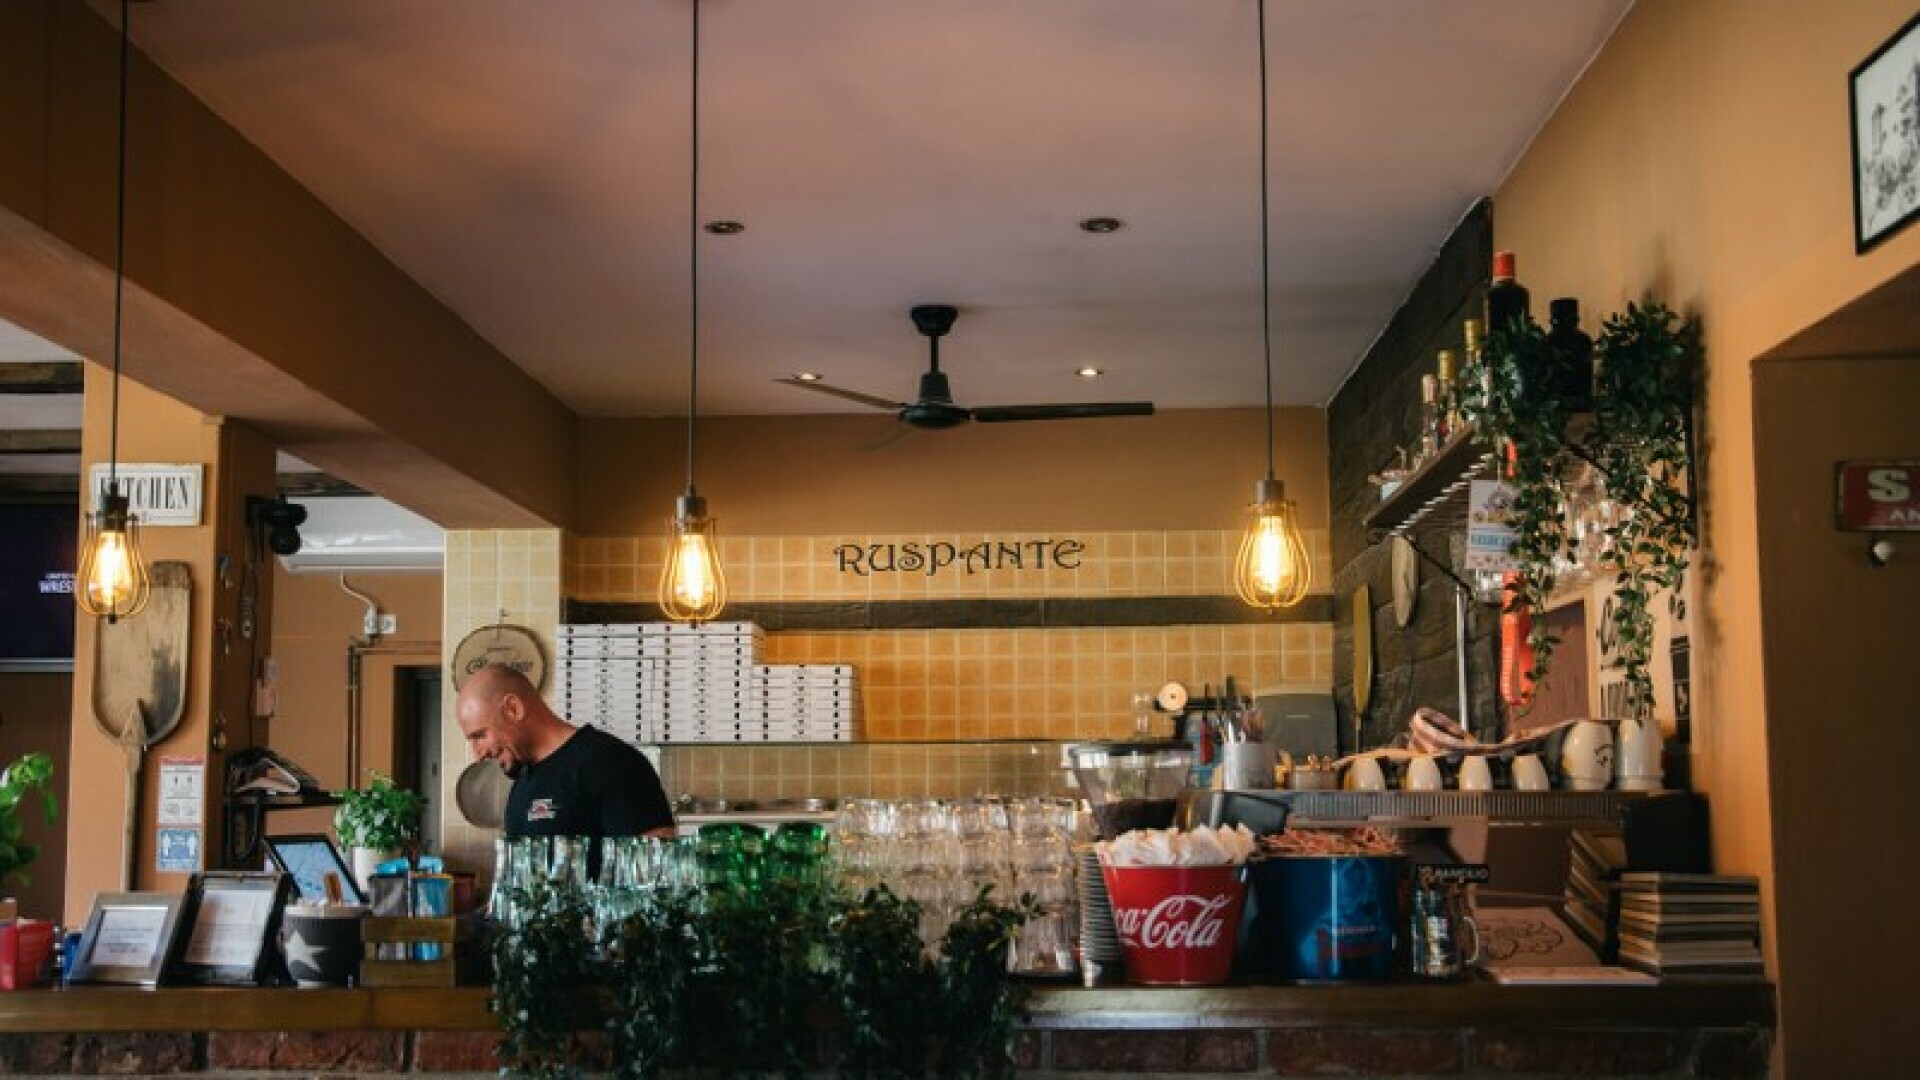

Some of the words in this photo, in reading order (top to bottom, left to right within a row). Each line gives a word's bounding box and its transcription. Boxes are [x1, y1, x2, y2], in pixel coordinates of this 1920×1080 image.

[100, 477, 191, 509] KTCHEN
[833, 539, 1086, 576] RUSPANTE
[38, 580, 75, 594] WRES
